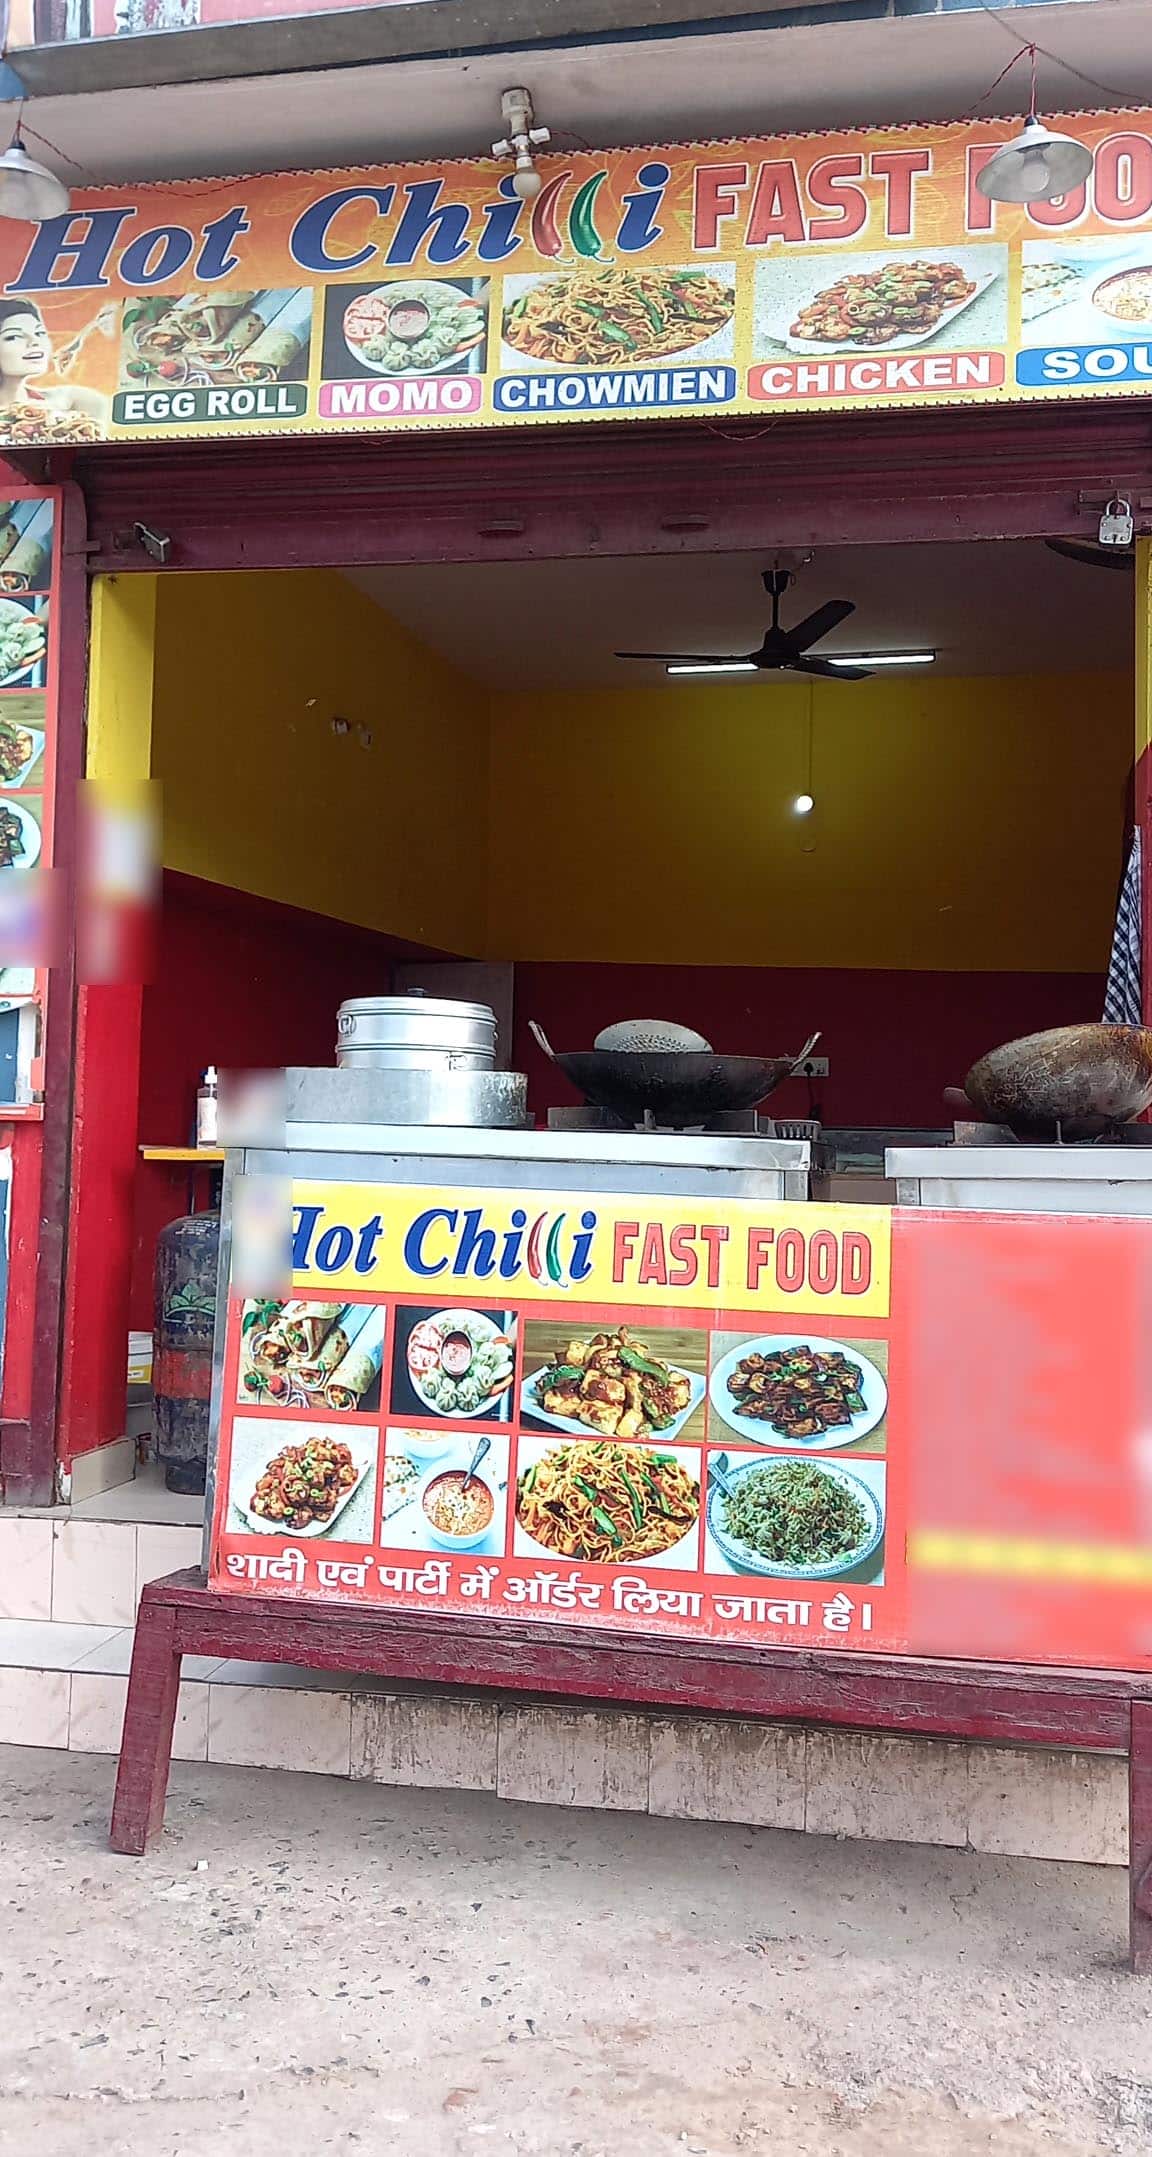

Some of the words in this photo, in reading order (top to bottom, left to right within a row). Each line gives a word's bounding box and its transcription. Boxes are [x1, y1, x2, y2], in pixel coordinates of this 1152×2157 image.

[4, 206, 250, 293] Hot
[290, 162, 671, 274] Chilli
[692, 149, 931, 250] FAST
[500, 369, 727, 407] CHOWMIEN
[760, 353, 990, 394] CHICKEN
[123, 392, 195, 420] EGG
[206, 387, 297, 417] ROLL
[330, 380, 473, 414] MOMO
[403, 1207, 597, 1286] Chilli
[612, 1221, 729, 1288] FAST
[747, 1226, 872, 1295] FOOD
[226, 1548, 308, 1583] शादी
[316, 1555, 375, 1588] एवं
[378, 1559, 452, 1596] पार्टी
[459, 1565, 500, 1599] में
[502, 1570, 604, 1609] ऑर्डर
[611, 1576, 704, 1618] लिया
[711, 1592, 812, 1626] जाता
